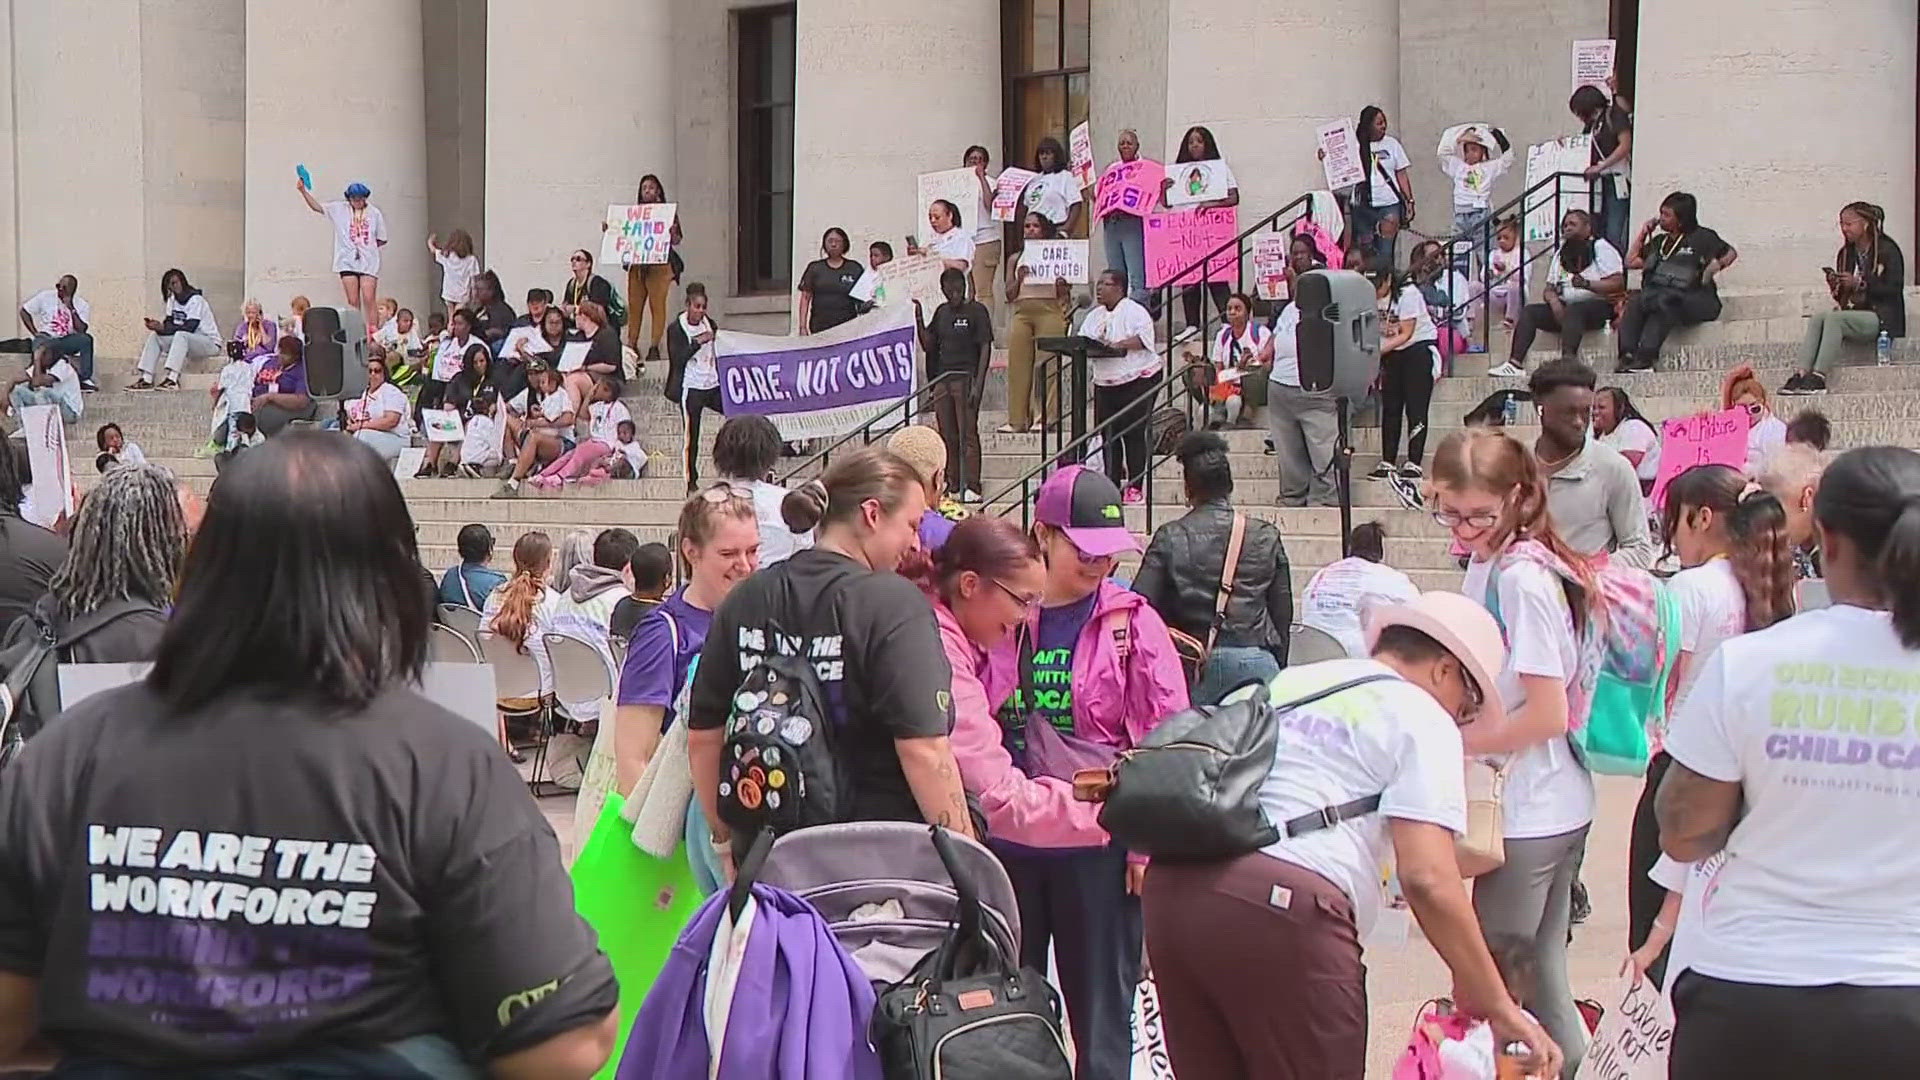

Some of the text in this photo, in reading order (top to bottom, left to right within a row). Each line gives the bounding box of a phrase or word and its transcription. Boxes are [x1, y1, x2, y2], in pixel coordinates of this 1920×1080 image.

[626, 206, 652, 221] WE
[1031, 264, 1051, 278] NOT
[727, 364, 792, 404] CARE,
[796, 356, 842, 398] NOT
[738, 626, 766, 651] WE
[1769, 689, 1906, 735] RUNS
[1766, 734, 1873, 765] CHILD
[89, 825, 377, 883] WE ARE THE
[91, 873, 378, 929] WORKFORCE
